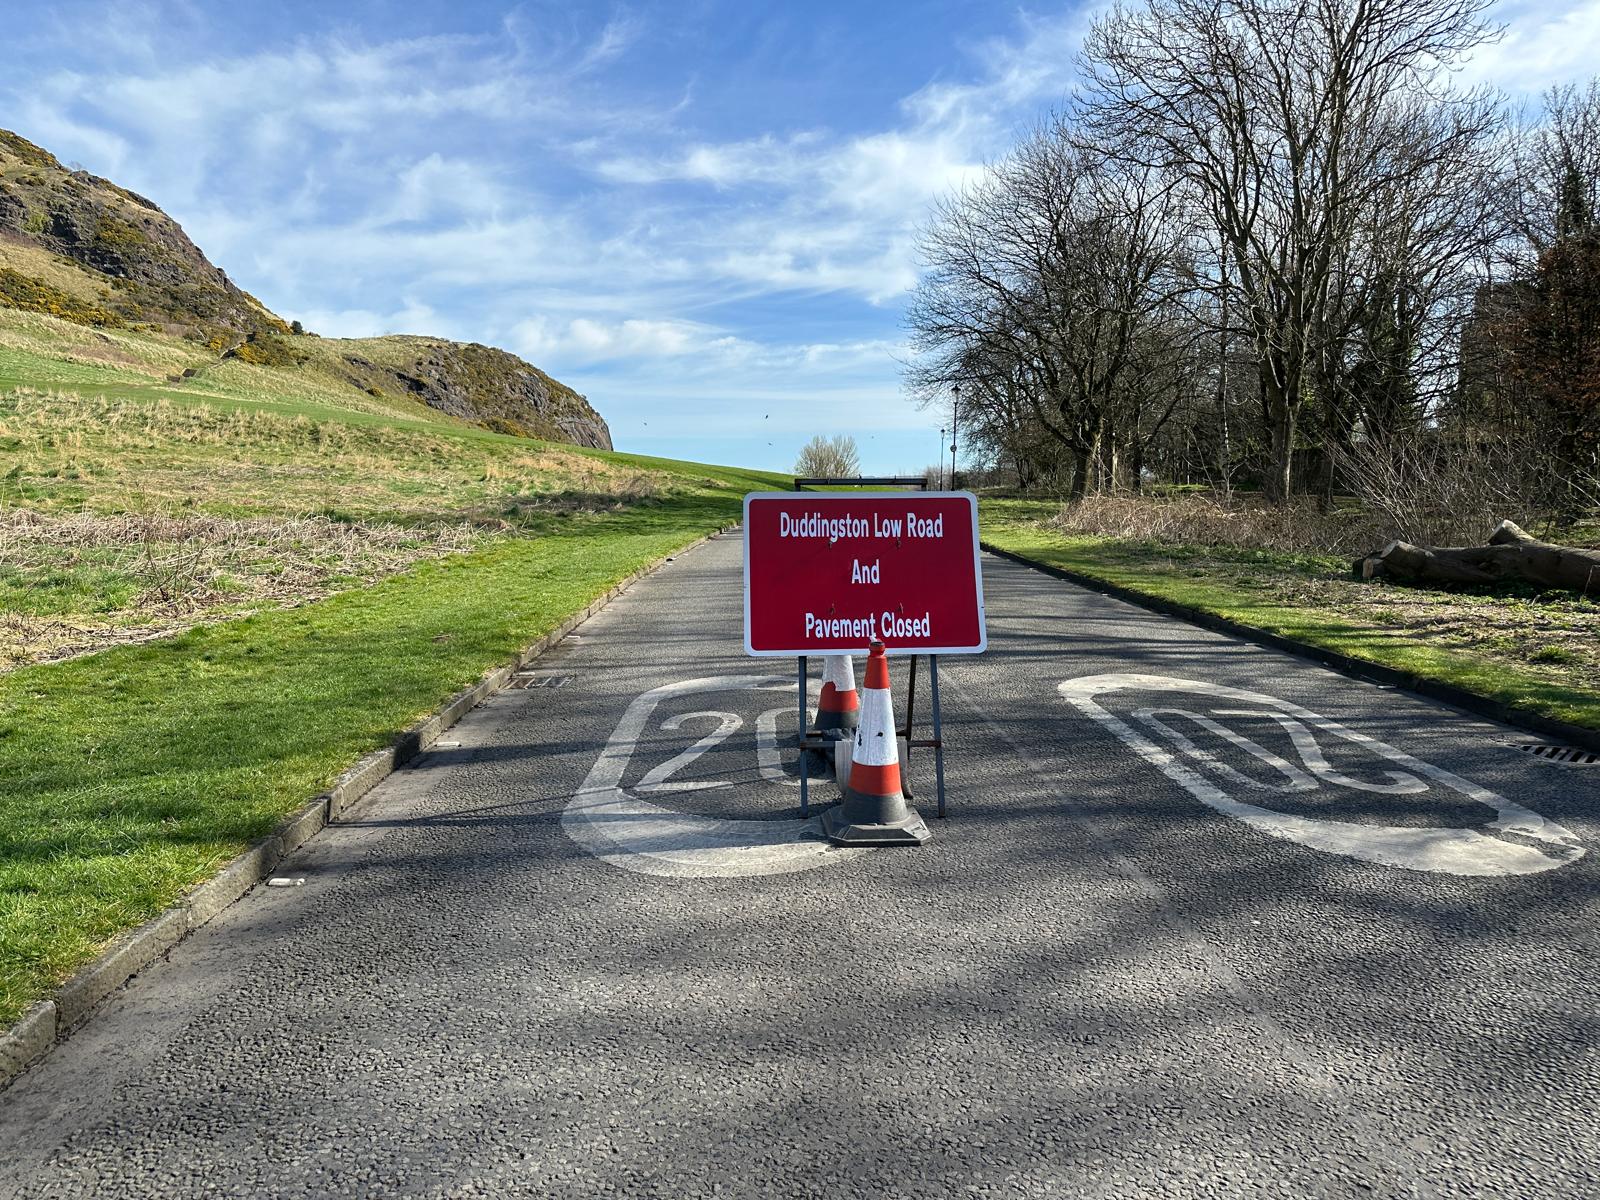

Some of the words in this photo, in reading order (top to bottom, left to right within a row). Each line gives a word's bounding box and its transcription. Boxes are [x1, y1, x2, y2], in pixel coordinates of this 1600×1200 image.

[780, 511, 869, 543] Duddingston
[874, 512, 902, 538] Low
[906, 512, 943, 538] Road
[851, 558, 880, 584] And
[805, 612, 876, 638] Pavement
[880, 611, 931, 638] Closed
